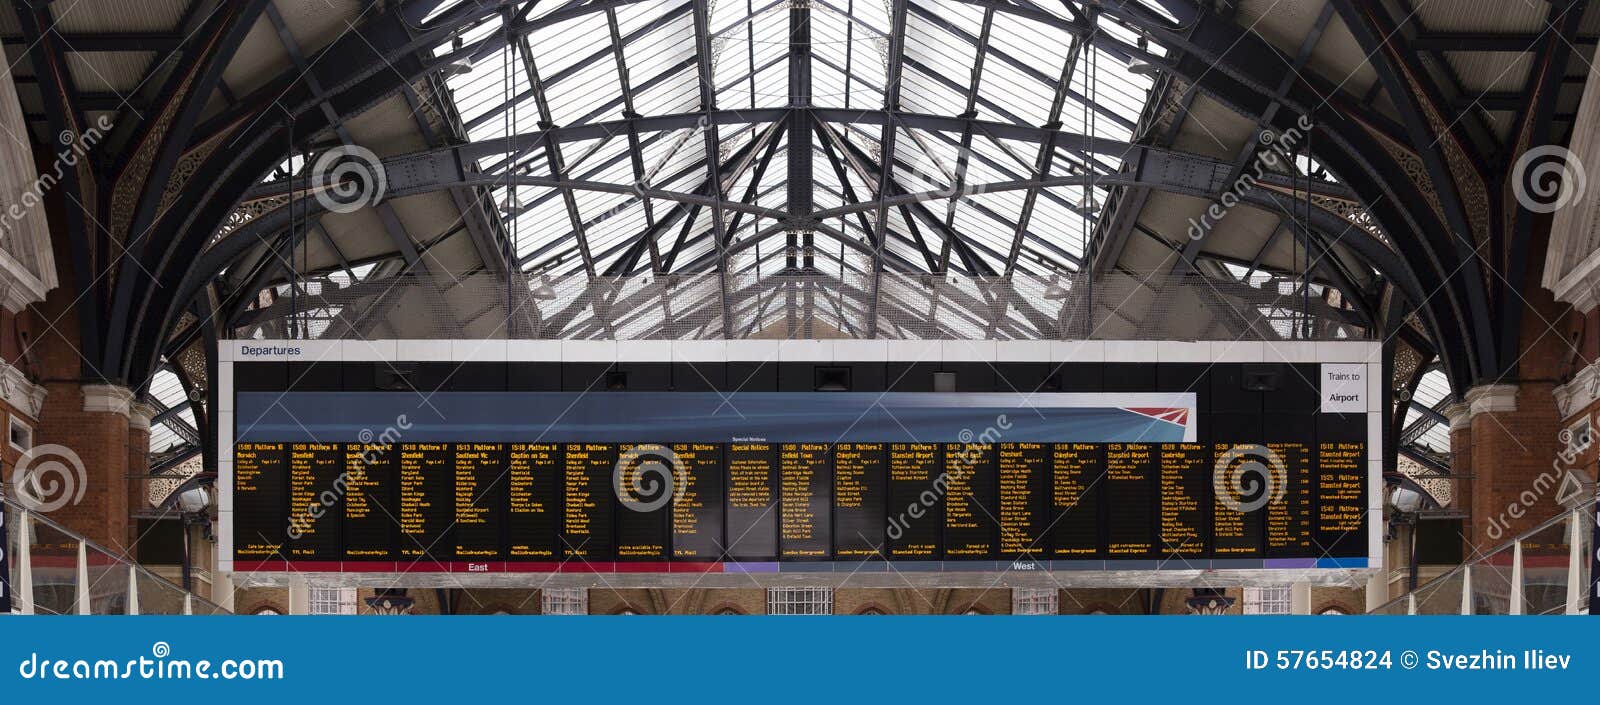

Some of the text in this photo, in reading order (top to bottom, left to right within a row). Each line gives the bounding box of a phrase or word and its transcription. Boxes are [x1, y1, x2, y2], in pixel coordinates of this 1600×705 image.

[241, 345, 301, 357] Departures
[1328, 372, 1361, 381] Trains to
[1329, 393, 1360, 404] Airport
[1013, 562, 1035, 570] West
